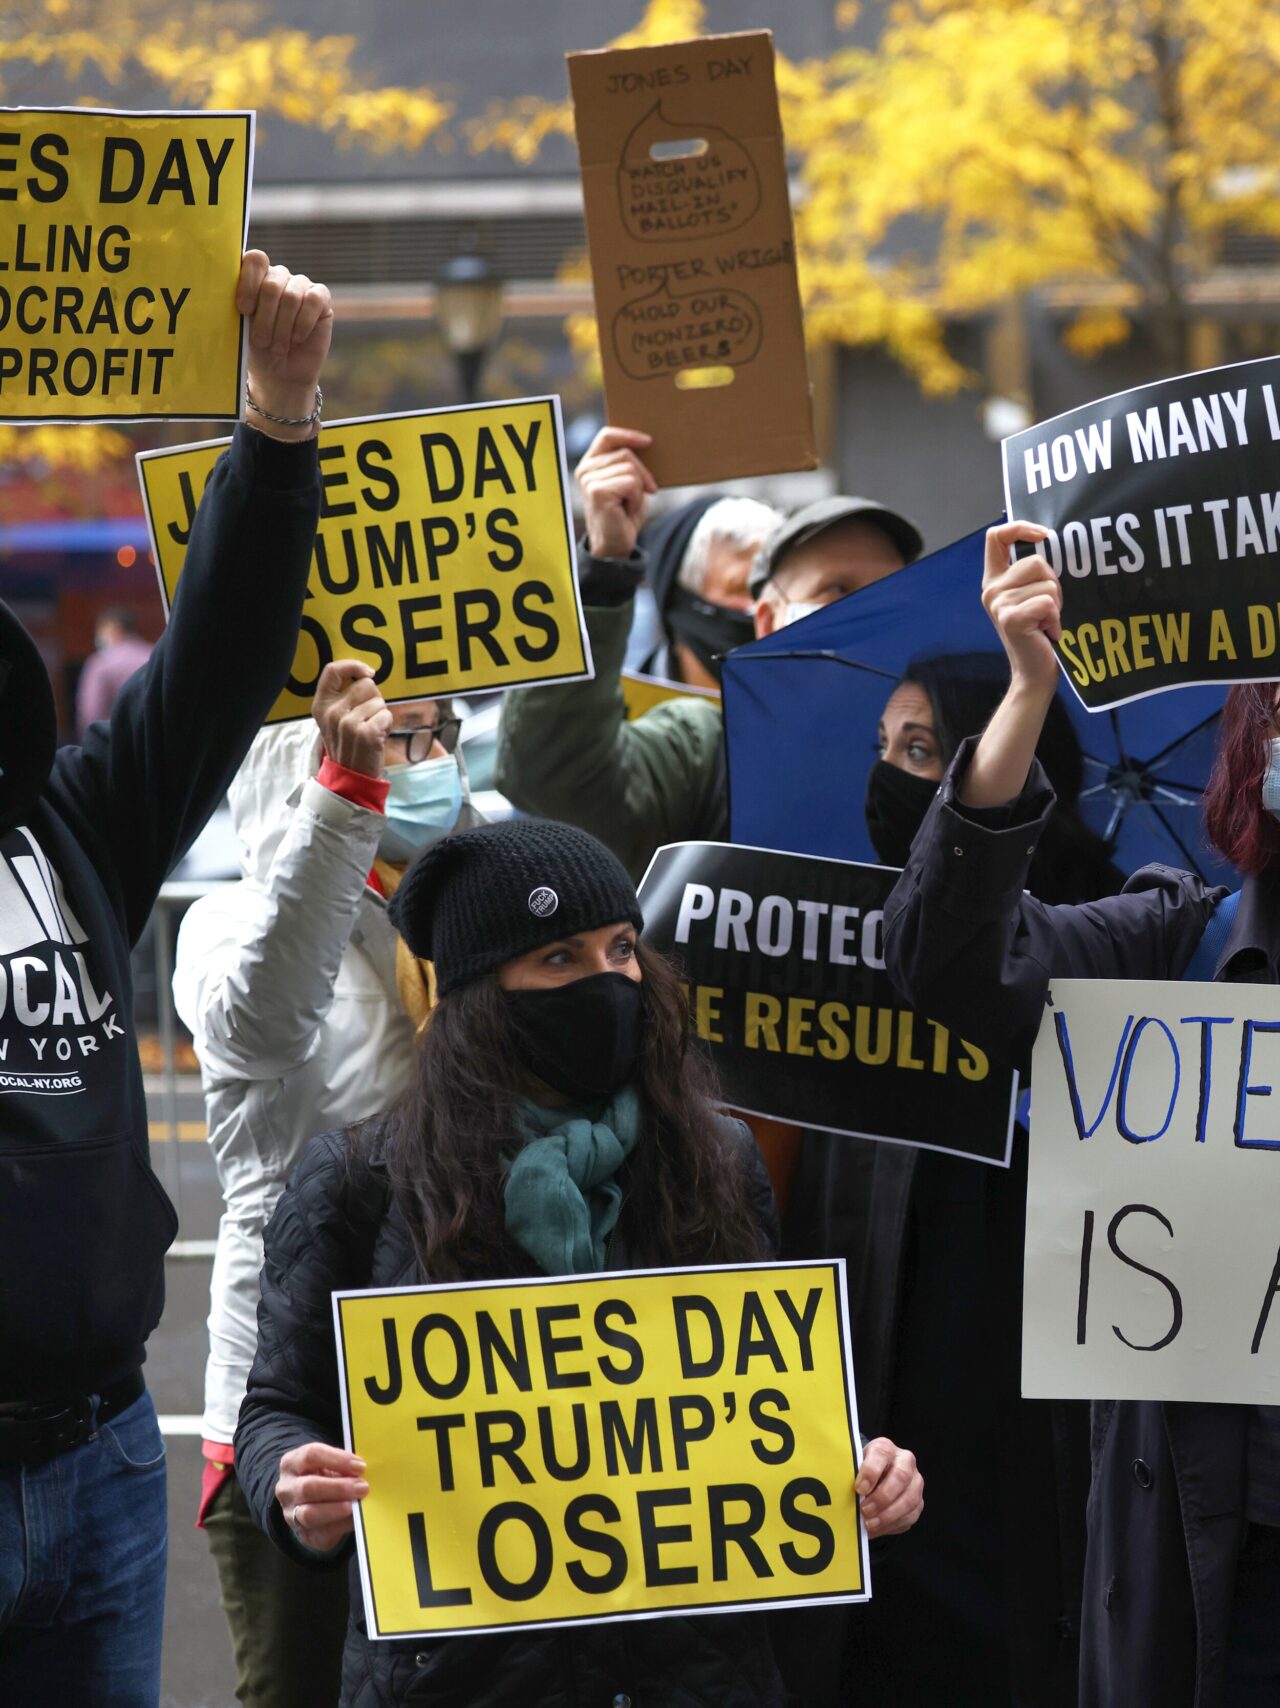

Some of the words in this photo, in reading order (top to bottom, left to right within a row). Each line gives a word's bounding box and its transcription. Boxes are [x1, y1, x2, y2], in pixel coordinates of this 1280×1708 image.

[605, 65, 690, 94] JONES
[706, 56, 753, 81] DAY
[99, 137, 235, 205] DAY
[631, 167, 748, 198] DISQUALIFY
[617, 258, 711, 290] PORTER
[691, 294, 740, 316] OUR
[0, 347, 175, 396] PROFIT
[1023, 419, 1112, 494] HOW
[1126, 388, 1248, 464] MANY
[167, 439, 400, 545] JES
[420, 421, 542, 504] DAY
[306, 507, 524, 599] UMP'S
[1041, 512, 1146, 579] DOES
[1153, 504, 1192, 568] IT
[284, 580, 560, 698] OSERS
[1059, 612, 1191, 687] SCREW
[1208, 609, 1238, 661] A
[531, 890, 548, 910] FUCK
[536, 894, 554, 915] TRUMP
[29, 1013, 125, 1062] YORK
[1077, 1203, 1183, 1352] IS
[363, 1299, 644, 1406] JONES
[671, 1287, 823, 1380] DAY
[416, 1388, 795, 1492] TRUMP'S
[407, 1477, 836, 1609] LOSERS
